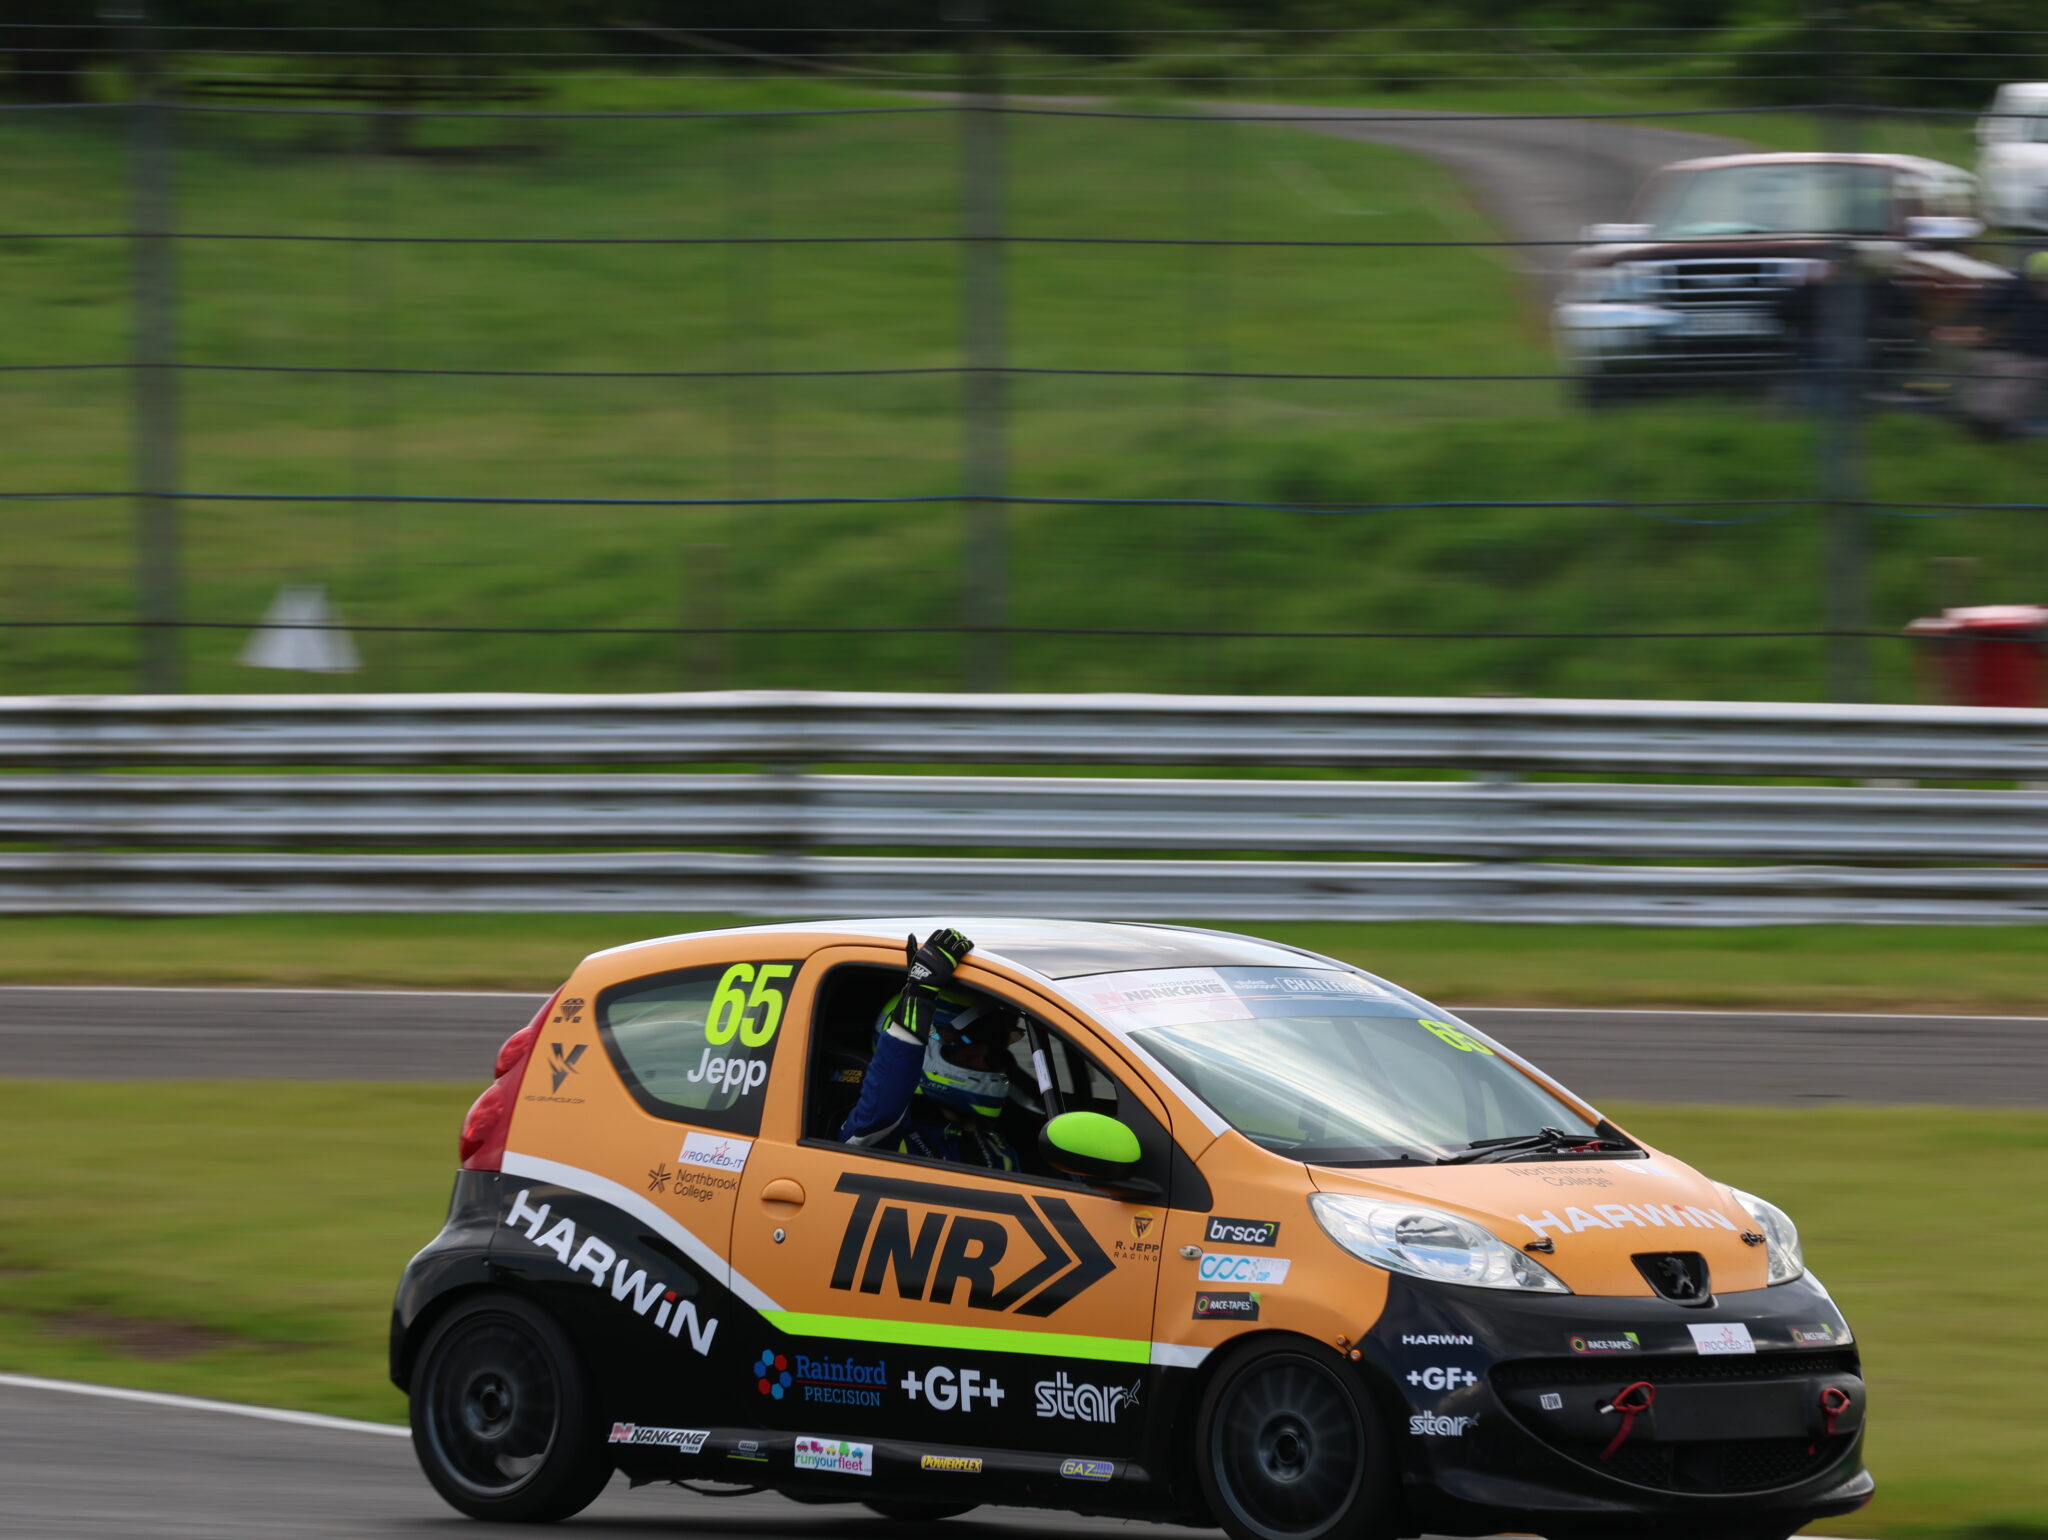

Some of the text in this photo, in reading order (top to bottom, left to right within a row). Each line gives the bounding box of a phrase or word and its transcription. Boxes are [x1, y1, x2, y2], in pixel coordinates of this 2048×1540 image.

[1123, 983, 1226, 1002] NANKANG
[705, 963, 794, 1047] 65
[1417, 1019, 1496, 1056] 65
[687, 1048, 767, 1095] Jepp
[676, 1168, 737, 1190] Northbrook
[1506, 1165, 1613, 1178] Northbrook
[1542, 1175, 1614, 1188] College
[673, 1182, 713, 1202] College
[1210, 1219, 1268, 1243] brscc
[1113, 1251, 1158, 1262] RACING
[1129, 1242, 1160, 1253] JEPP
[1209, 1300, 1251, 1311] RACE-TAPES
[795, 1355, 887, 1385] Rainford
[804, 1385, 881, 1408] PRECISION
[1034, 1371, 1125, 1424] star
[1409, 1409, 1469, 1437] star
[631, 1430, 708, 1446] NANKANG
[921, 1455, 982, 1471] POWERFLEX
[1063, 1461, 1097, 1476] GAZ
